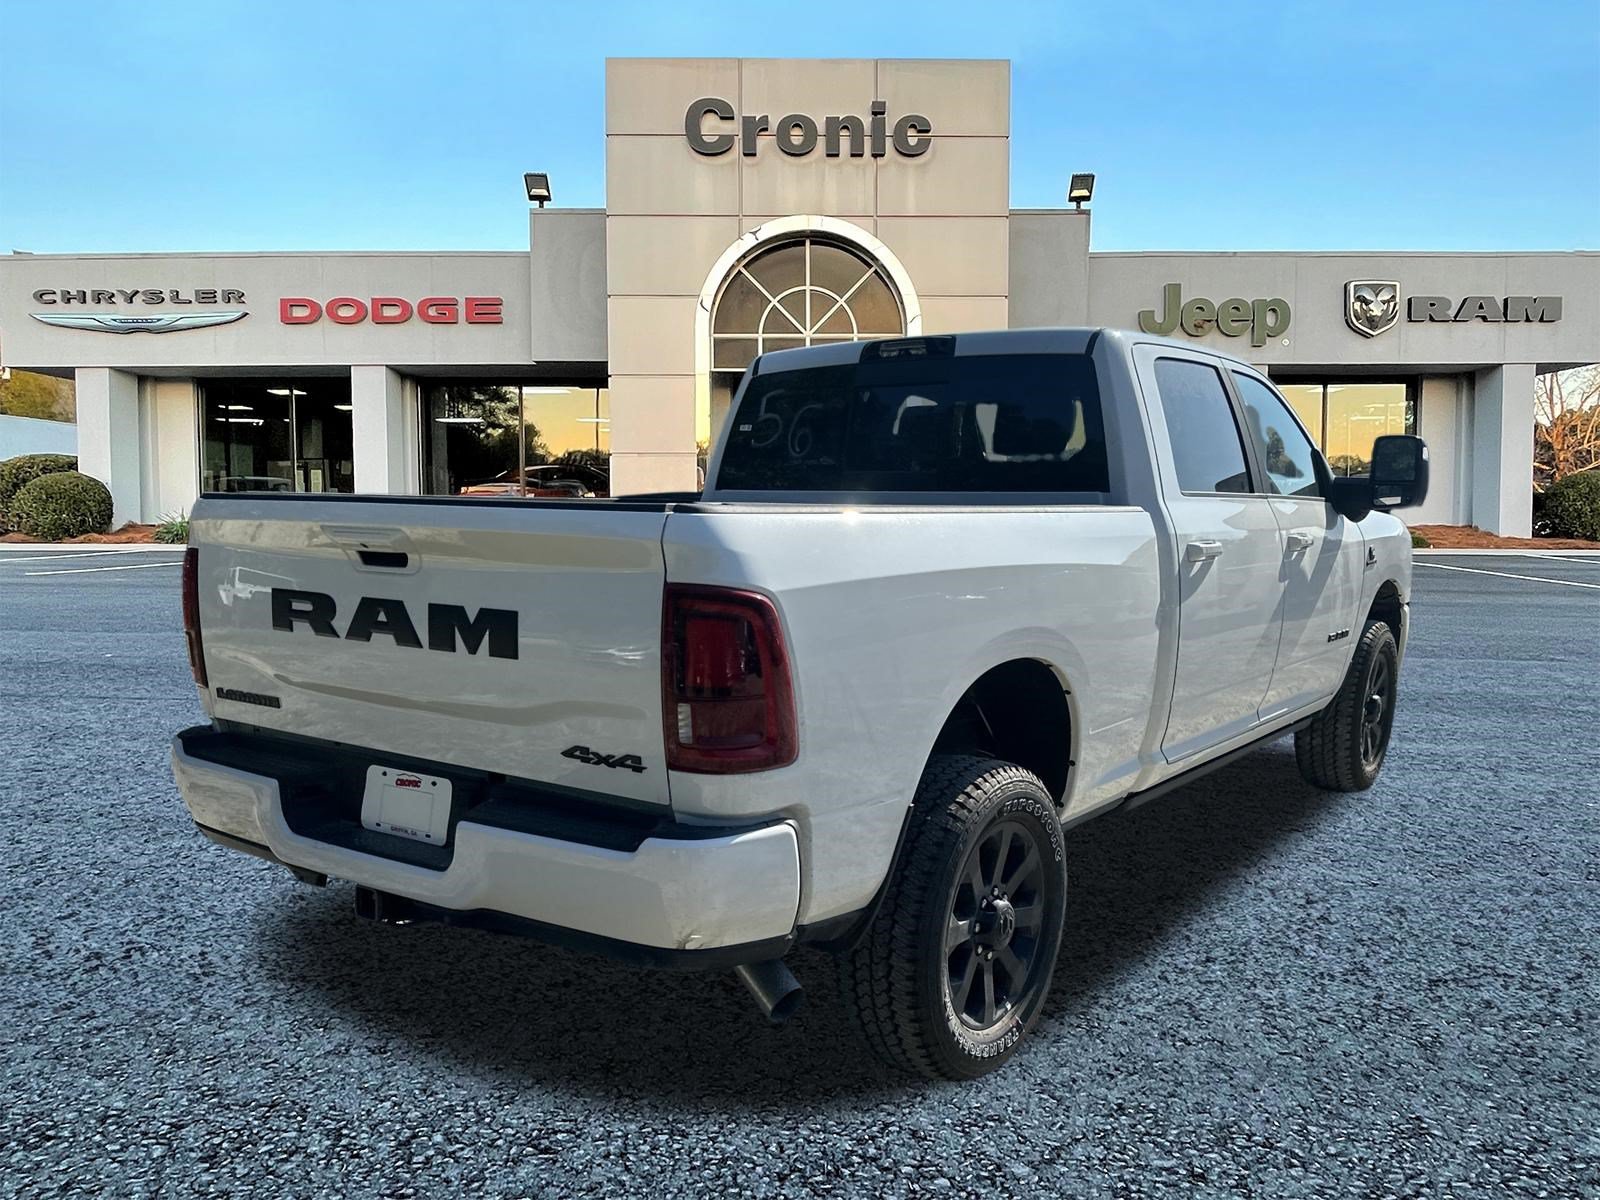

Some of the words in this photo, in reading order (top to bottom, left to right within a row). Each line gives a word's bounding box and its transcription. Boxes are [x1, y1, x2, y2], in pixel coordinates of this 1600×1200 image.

[685, 97, 932, 157] Cronic
[32, 289, 246, 304] CHRYSLER
[279, 296, 504, 325] DODGE
[1138, 283, 1292, 347] Jeep
[1406, 296, 1563, 323] RAM
[271, 587, 519, 660] RAM
